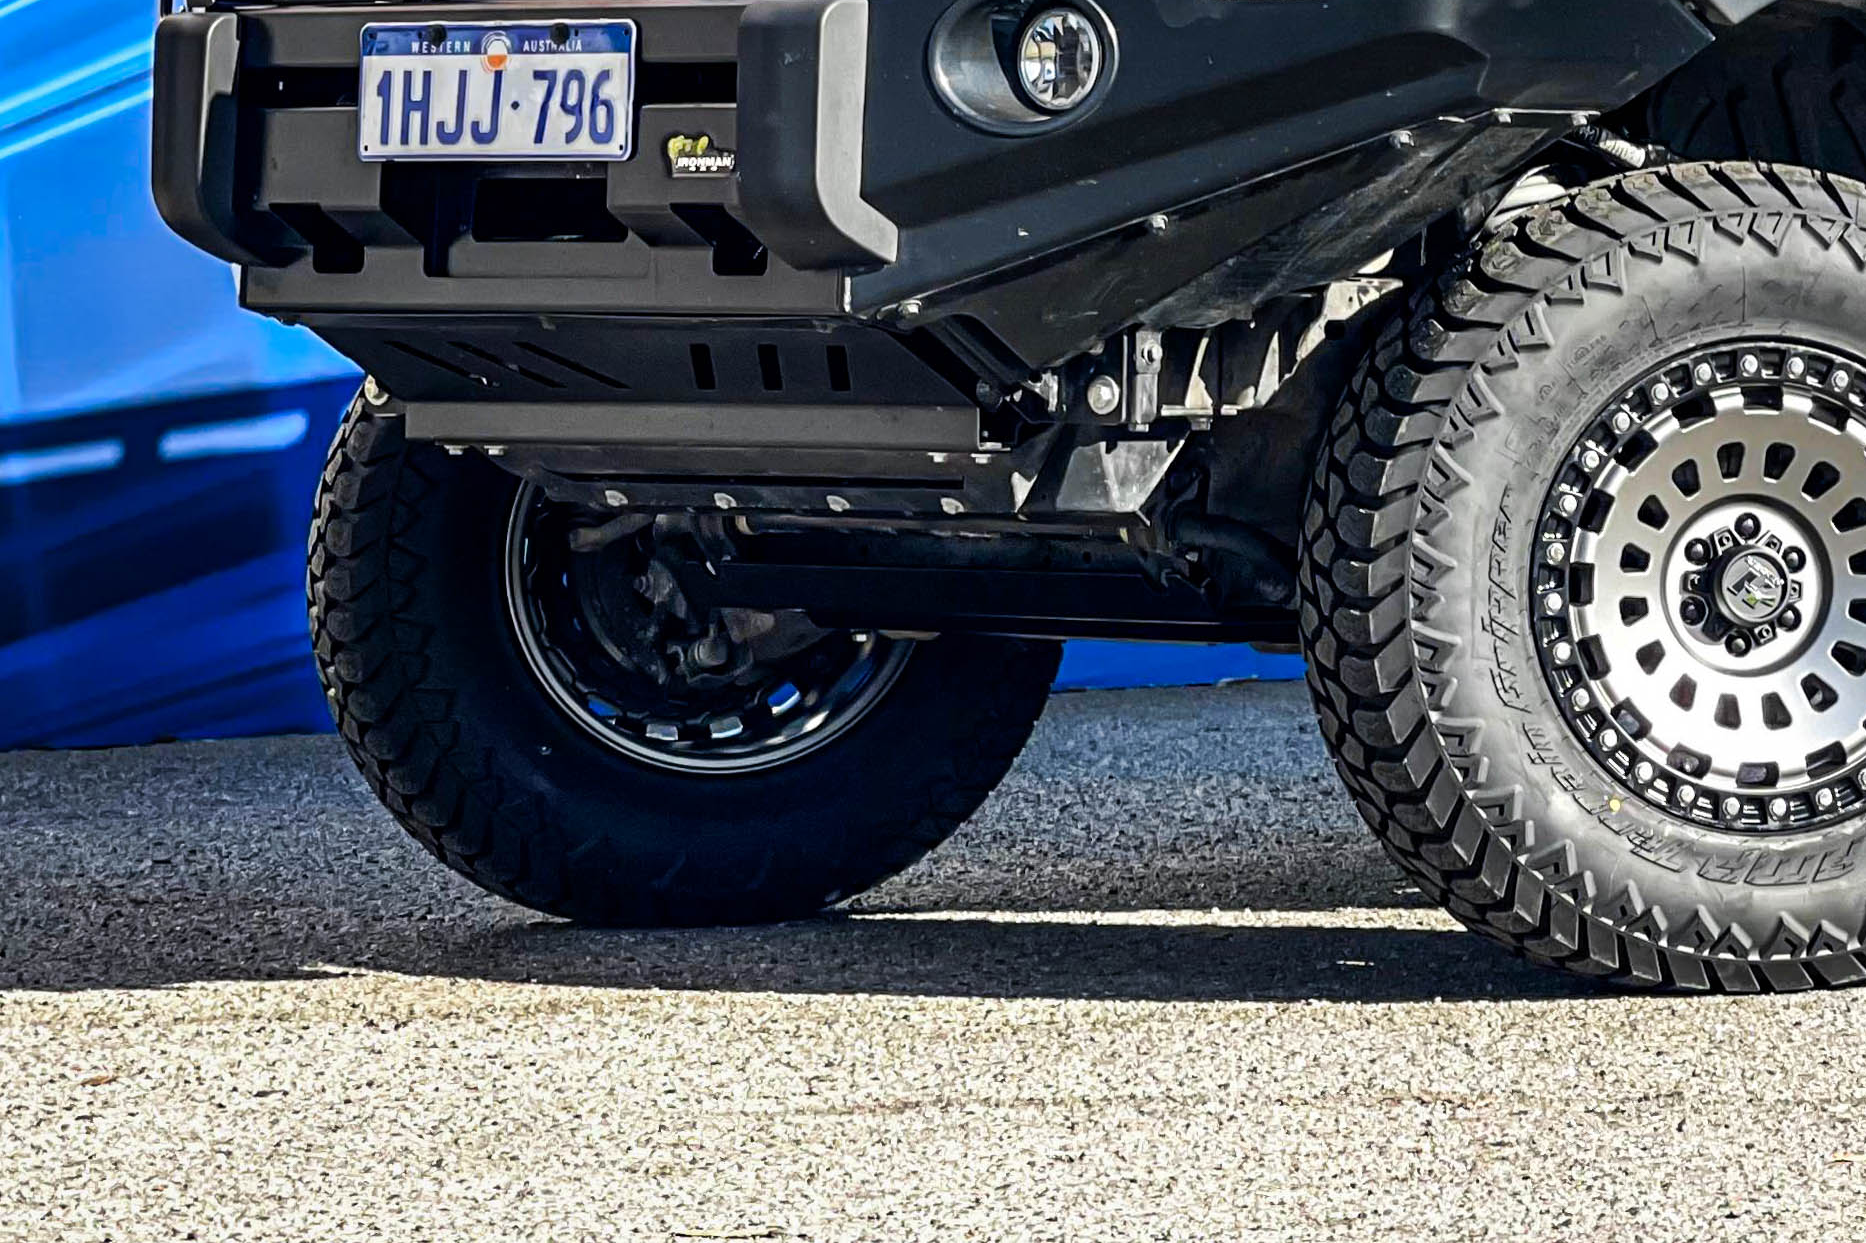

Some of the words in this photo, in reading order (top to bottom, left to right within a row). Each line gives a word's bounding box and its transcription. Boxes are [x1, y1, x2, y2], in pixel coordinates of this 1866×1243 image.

[411, 40, 471, 54] WESTERN
[522, 39, 583, 53] AUSTRALIA
[677, 156, 732, 168] IRONMAN
